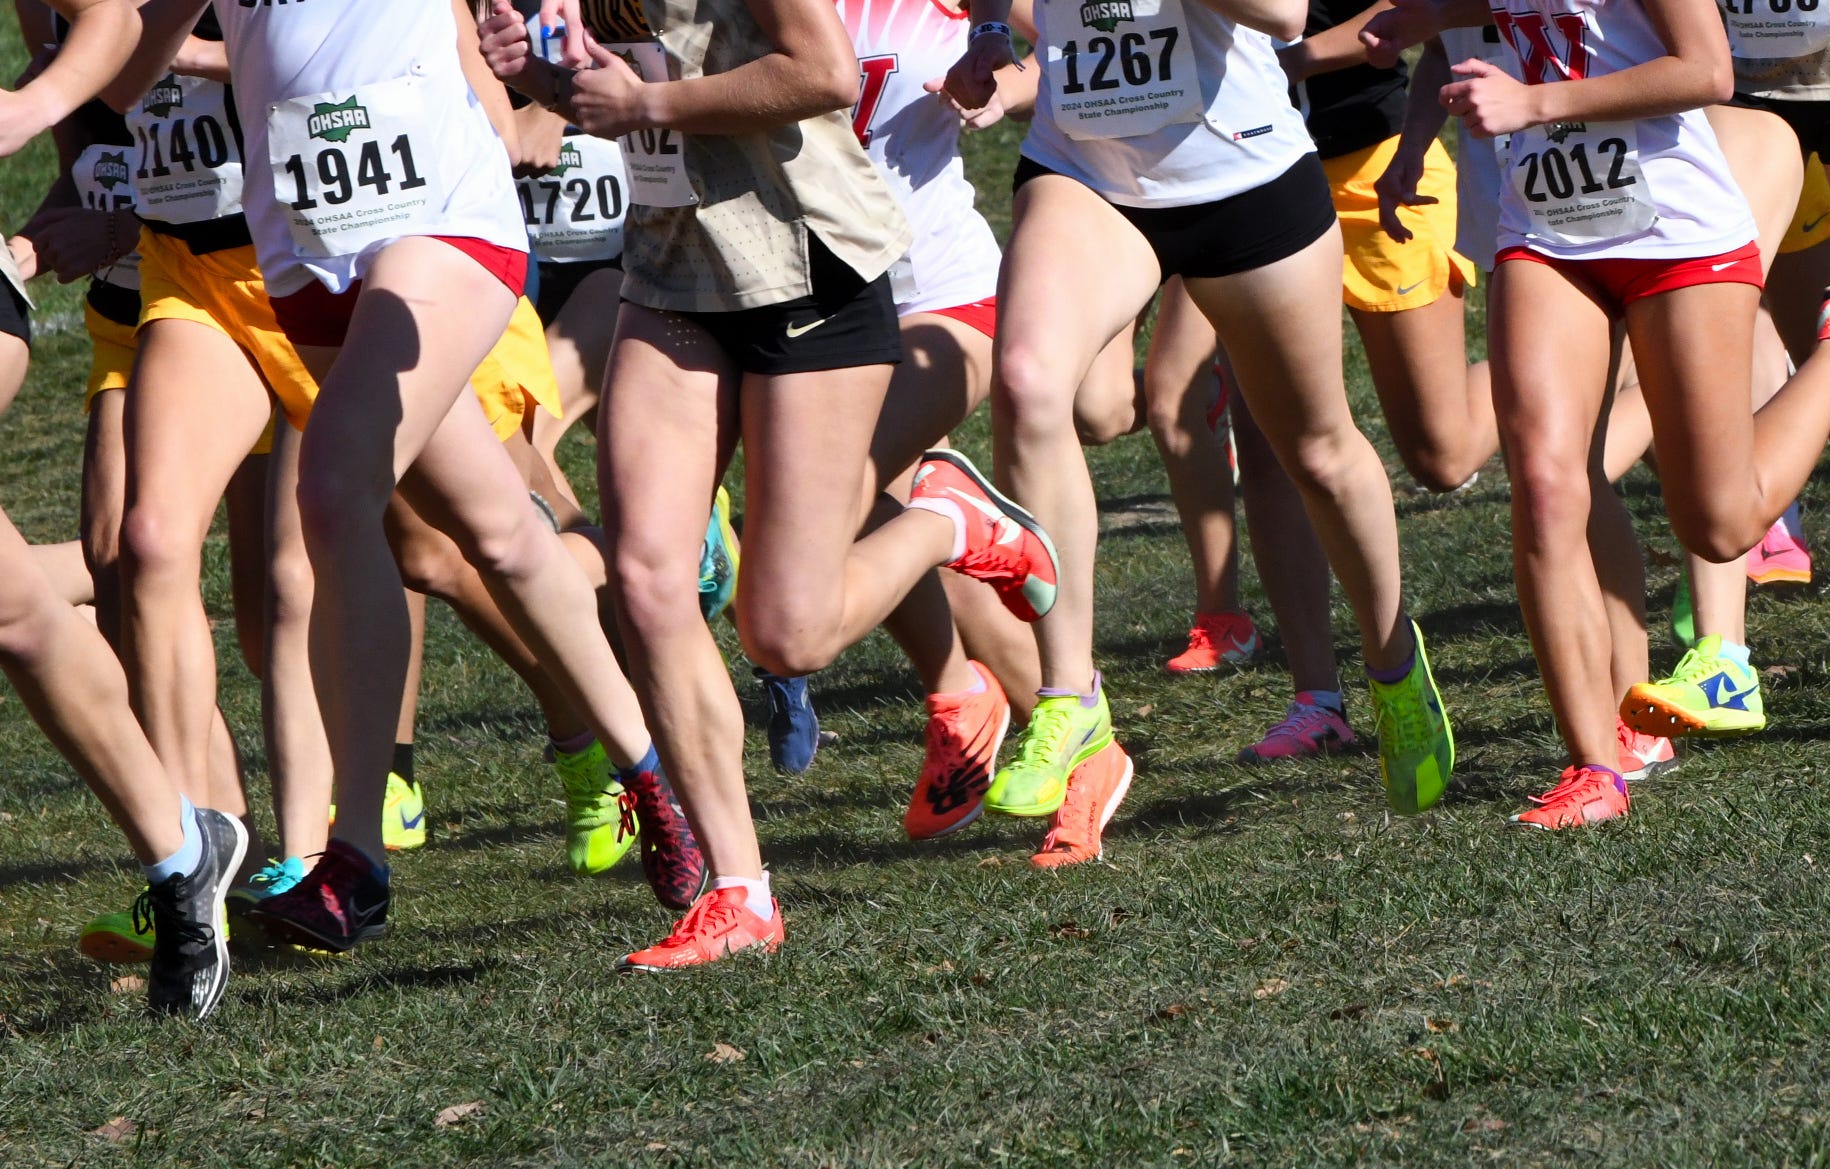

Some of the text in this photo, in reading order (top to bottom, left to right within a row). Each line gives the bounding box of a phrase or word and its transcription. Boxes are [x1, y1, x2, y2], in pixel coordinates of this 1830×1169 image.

[1083, 2, 1132, 23] OHSAA
[1062, 27, 1179, 95] 1267
[1061, 88, 1185, 112] 2024 OHSAA Cross Country
[1078, 101, 1169, 120] State Championship
[310, 108, 369, 134] OHSAA
[285, 134, 427, 211] 1941
[1519, 137, 1637, 202] 2012
[317, 212, 354, 226] OHSAA
[356, 208, 385, 218] Cross
[387, 198, 427, 212] Country
[518, 175, 622, 225] 1720
[1546, 206, 1576, 217] OHSAA
[1576, 202, 1601, 213] Cross
[340, 212, 411, 232] Championship
[1547, 207, 1624, 226] tate Championship
